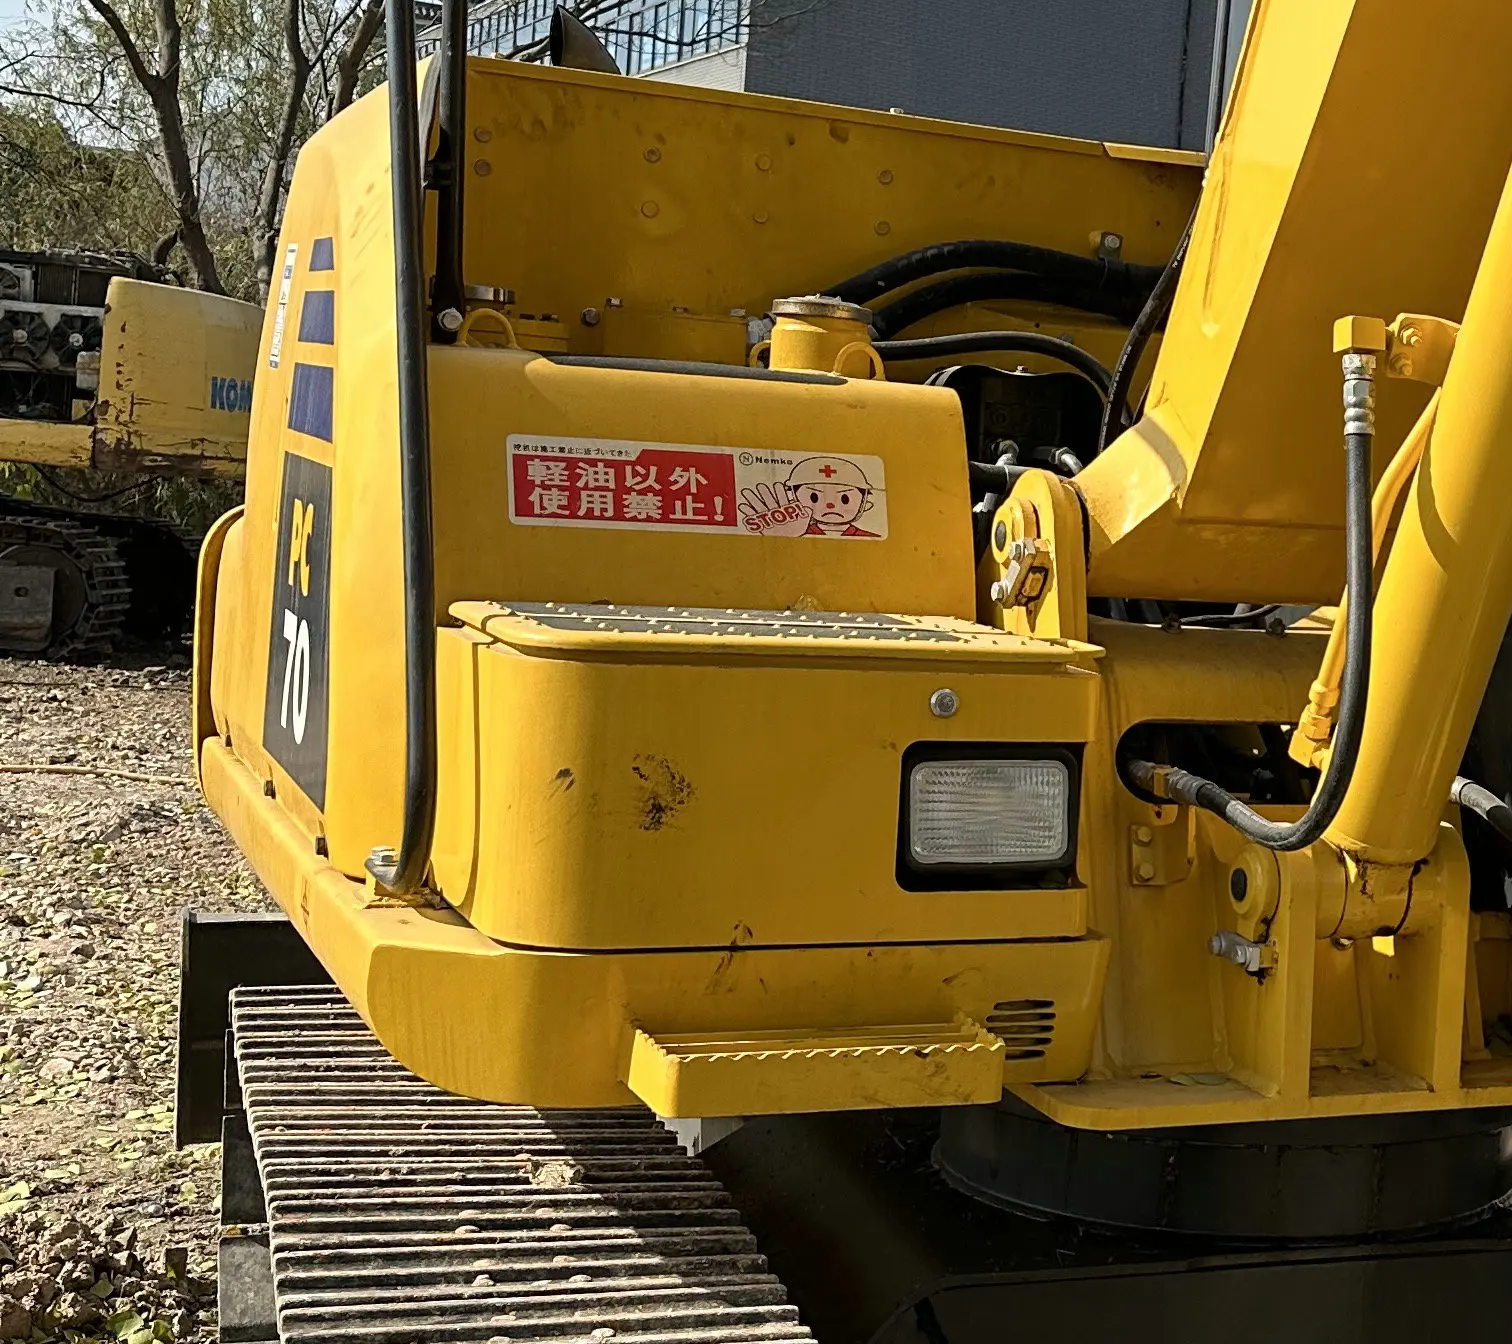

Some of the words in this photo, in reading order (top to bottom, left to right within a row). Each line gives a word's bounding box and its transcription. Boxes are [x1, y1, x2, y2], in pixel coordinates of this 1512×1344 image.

[527, 459, 709, 493] 軽油以外
[288, 498, 314, 597] PC
[280, 608, 310, 745] 70
